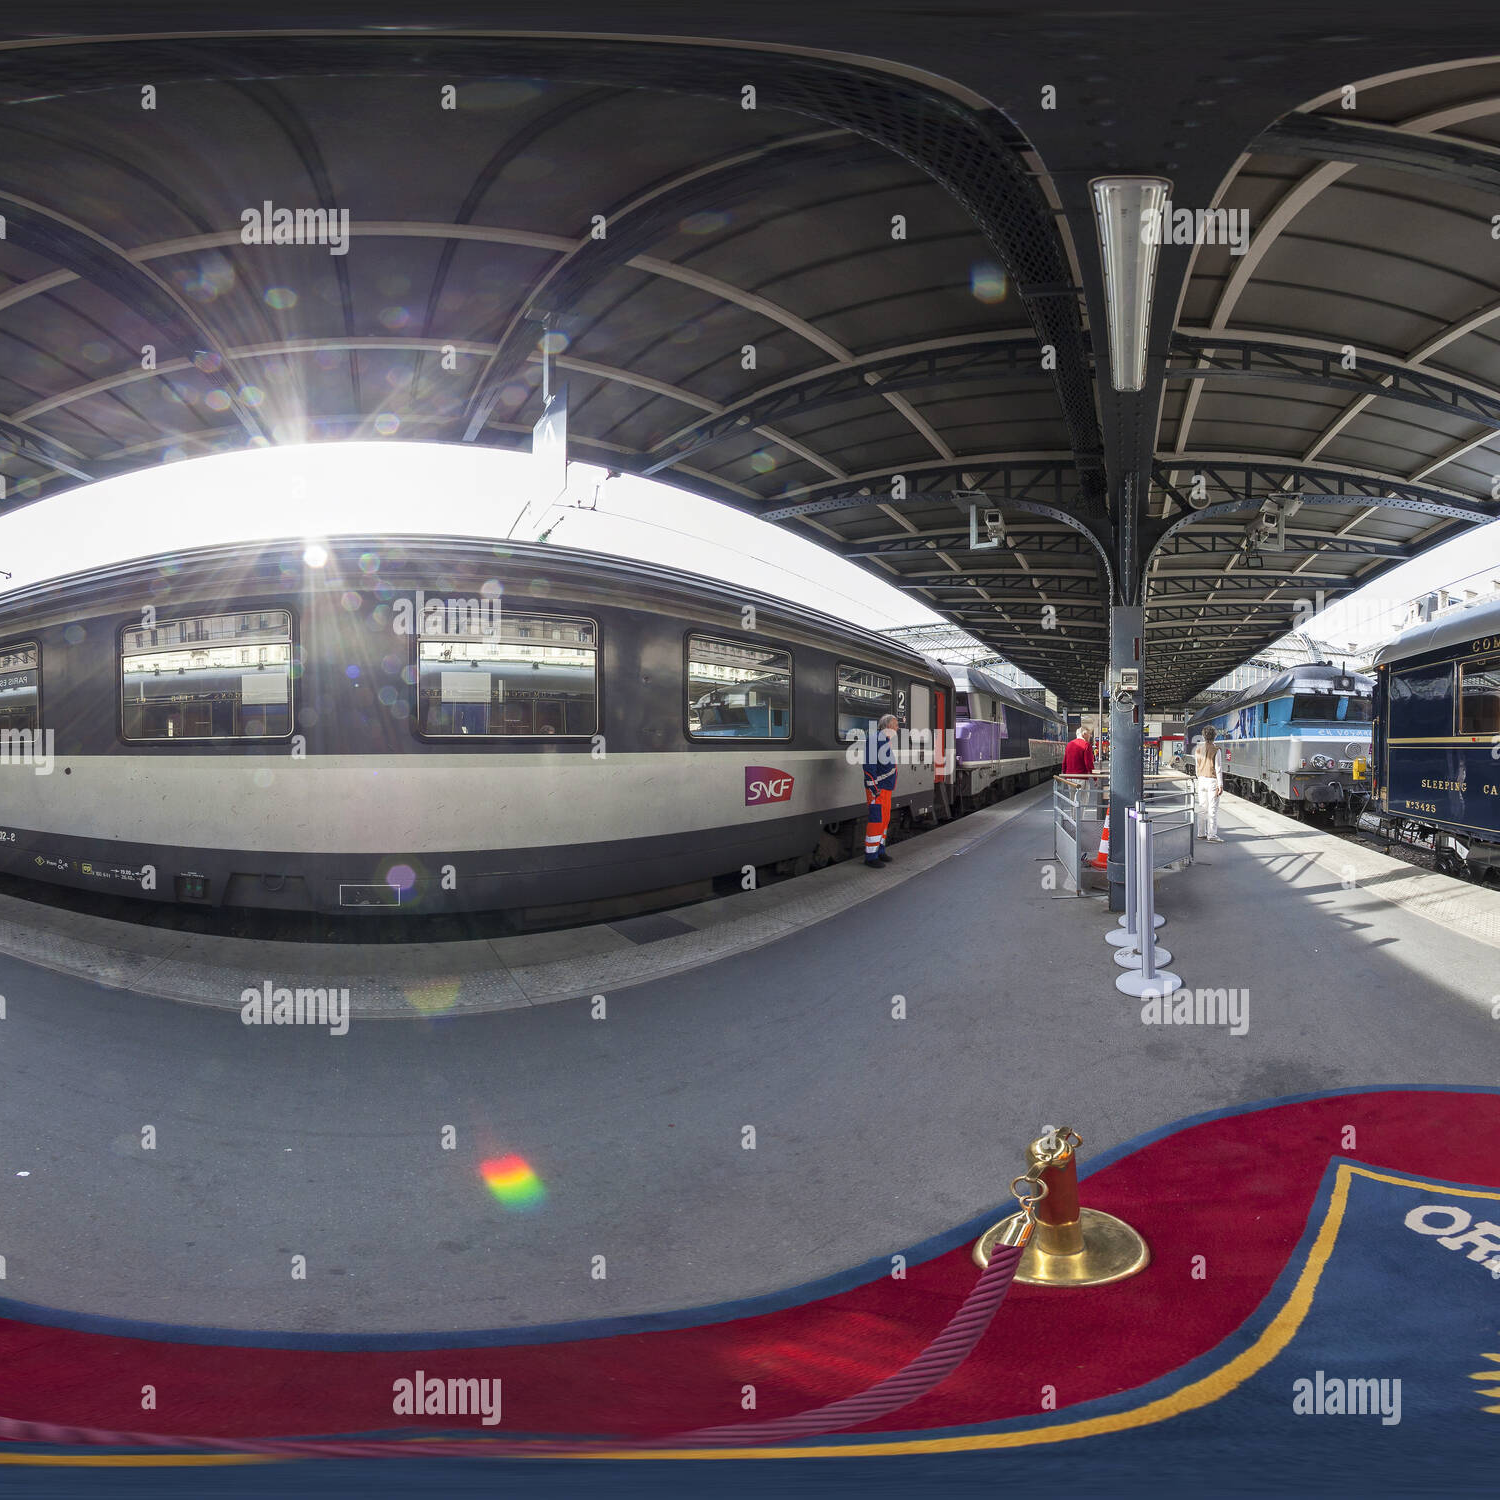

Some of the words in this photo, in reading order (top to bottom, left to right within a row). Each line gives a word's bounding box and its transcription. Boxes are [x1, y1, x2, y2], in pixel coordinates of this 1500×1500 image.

[898, 691, 905, 709] 2
[747, 778, 792, 801] SNCF
[1421, 780, 1467, 792] SLEEPING
